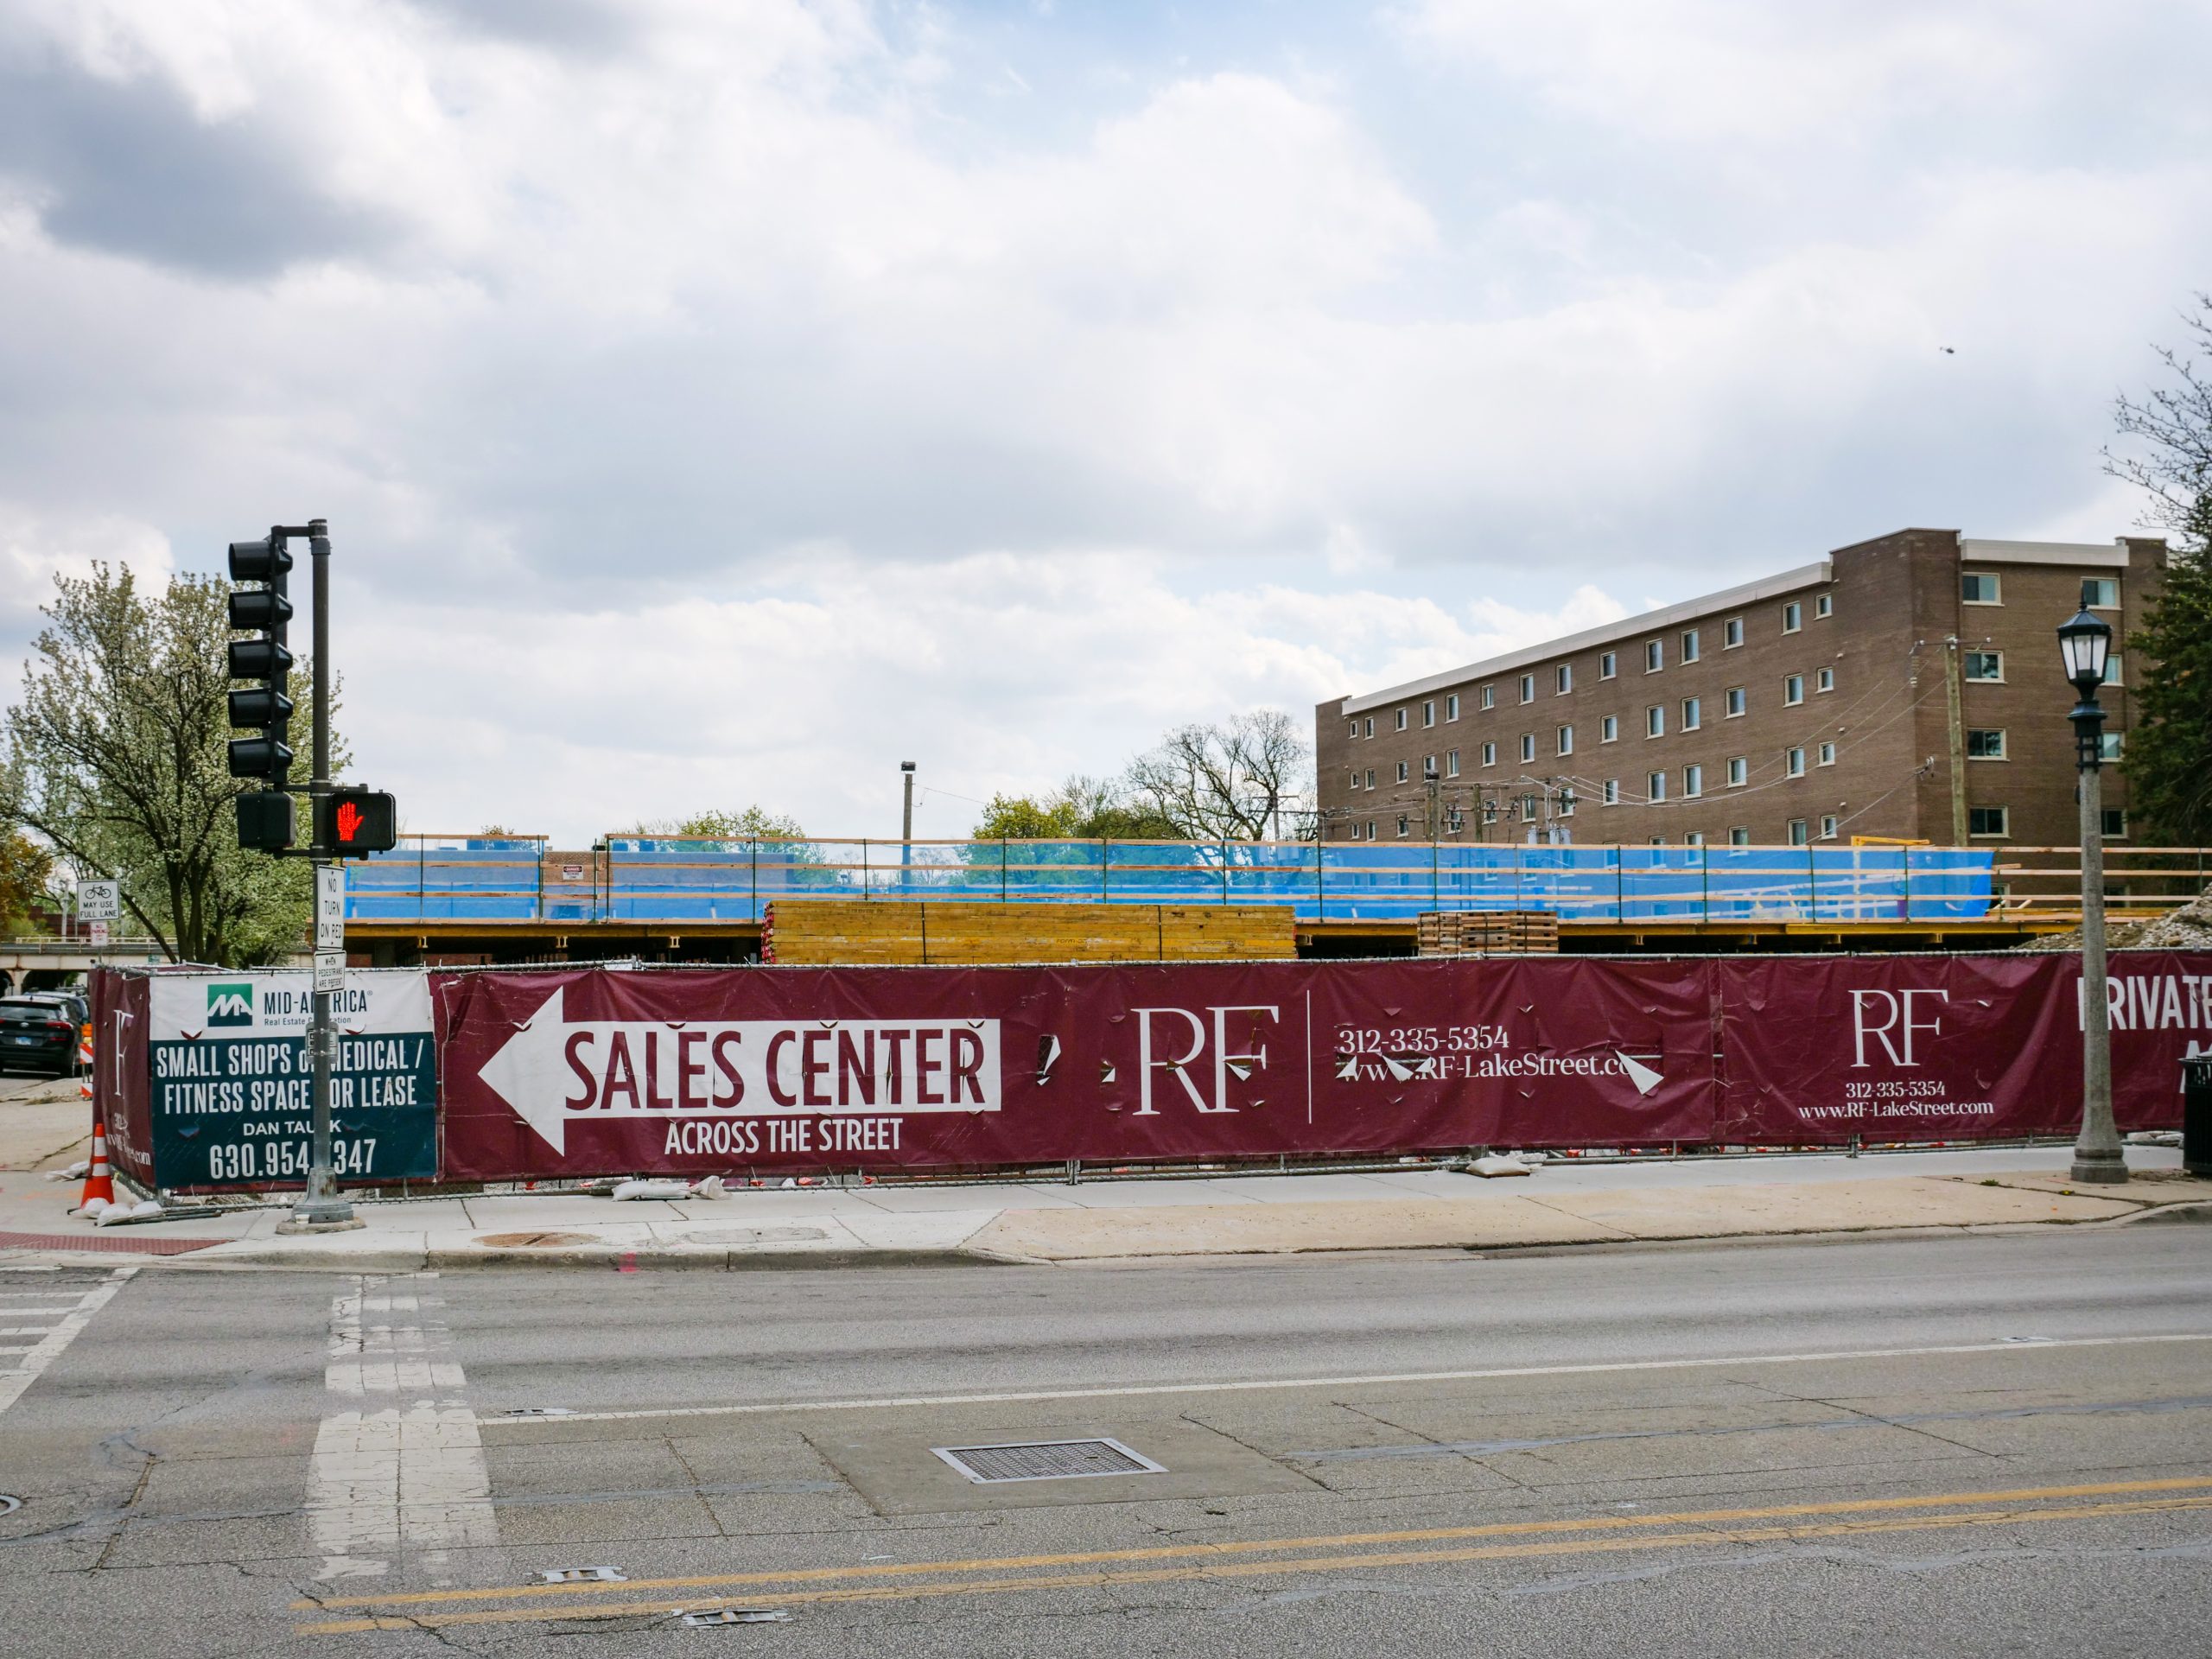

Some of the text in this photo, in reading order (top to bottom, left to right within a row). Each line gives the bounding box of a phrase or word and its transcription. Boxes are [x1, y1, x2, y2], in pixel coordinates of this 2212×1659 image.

[328, 877, 337, 893] NO
[99, 909, 118, 918] LANE
[324, 900, 340, 916] TURN
[321, 923, 342, 939] ON RED
[318, 968, 343, 977] PEDESTRIANS
[319, 978, 327, 988] ARE
[264, 1017, 280, 1027] Real
[283, 1016, 306, 1026] Estate
[1847, 988, 1950, 1068] RF
[1338, 1025, 1510, 1054] 312-335-5354
[156, 1045, 221, 1078] SMALL
[227, 1042, 292, 1077] SHOPS
[1130, 1004, 1281, 1116] RF
[563, 1027, 987, 1112] SALES CENTER
[164, 1074, 417, 1115] FITNESS SPACE OR LEASE
[1845, 1080, 1946, 1098] 312-335-5354
[1797, 1100, 1994, 1119] www.RF-LakeStreet.com
[243, 1119, 342, 1136] DAN TAUK
[664, 1117, 904, 1155] ACROSS THE STREET
[209, 1137, 378, 1179] 630.954347
